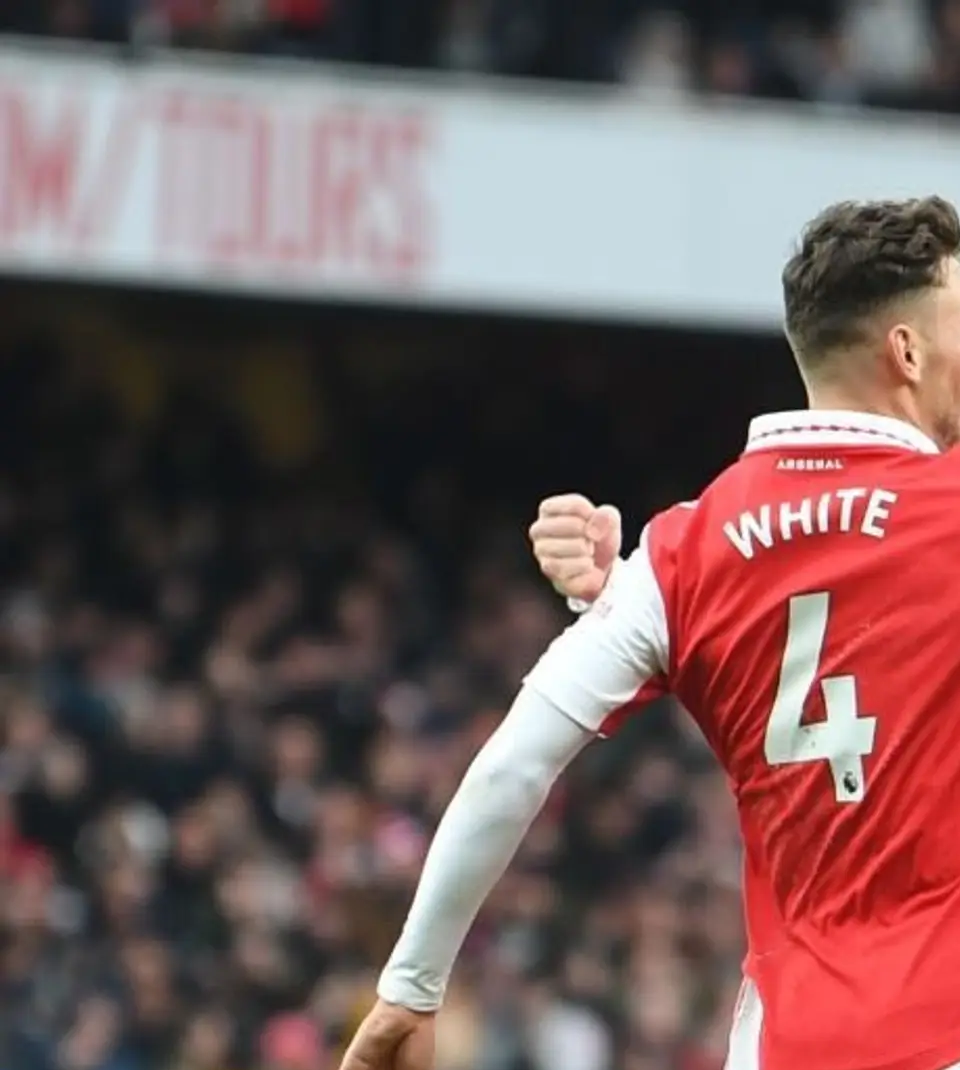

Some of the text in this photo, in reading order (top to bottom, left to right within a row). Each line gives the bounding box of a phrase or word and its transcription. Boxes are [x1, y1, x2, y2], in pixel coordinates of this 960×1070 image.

[776, 458, 844, 471] ARSENAL
[723, 486, 898, 561] WHITE
[764, 591, 877, 802] 4
